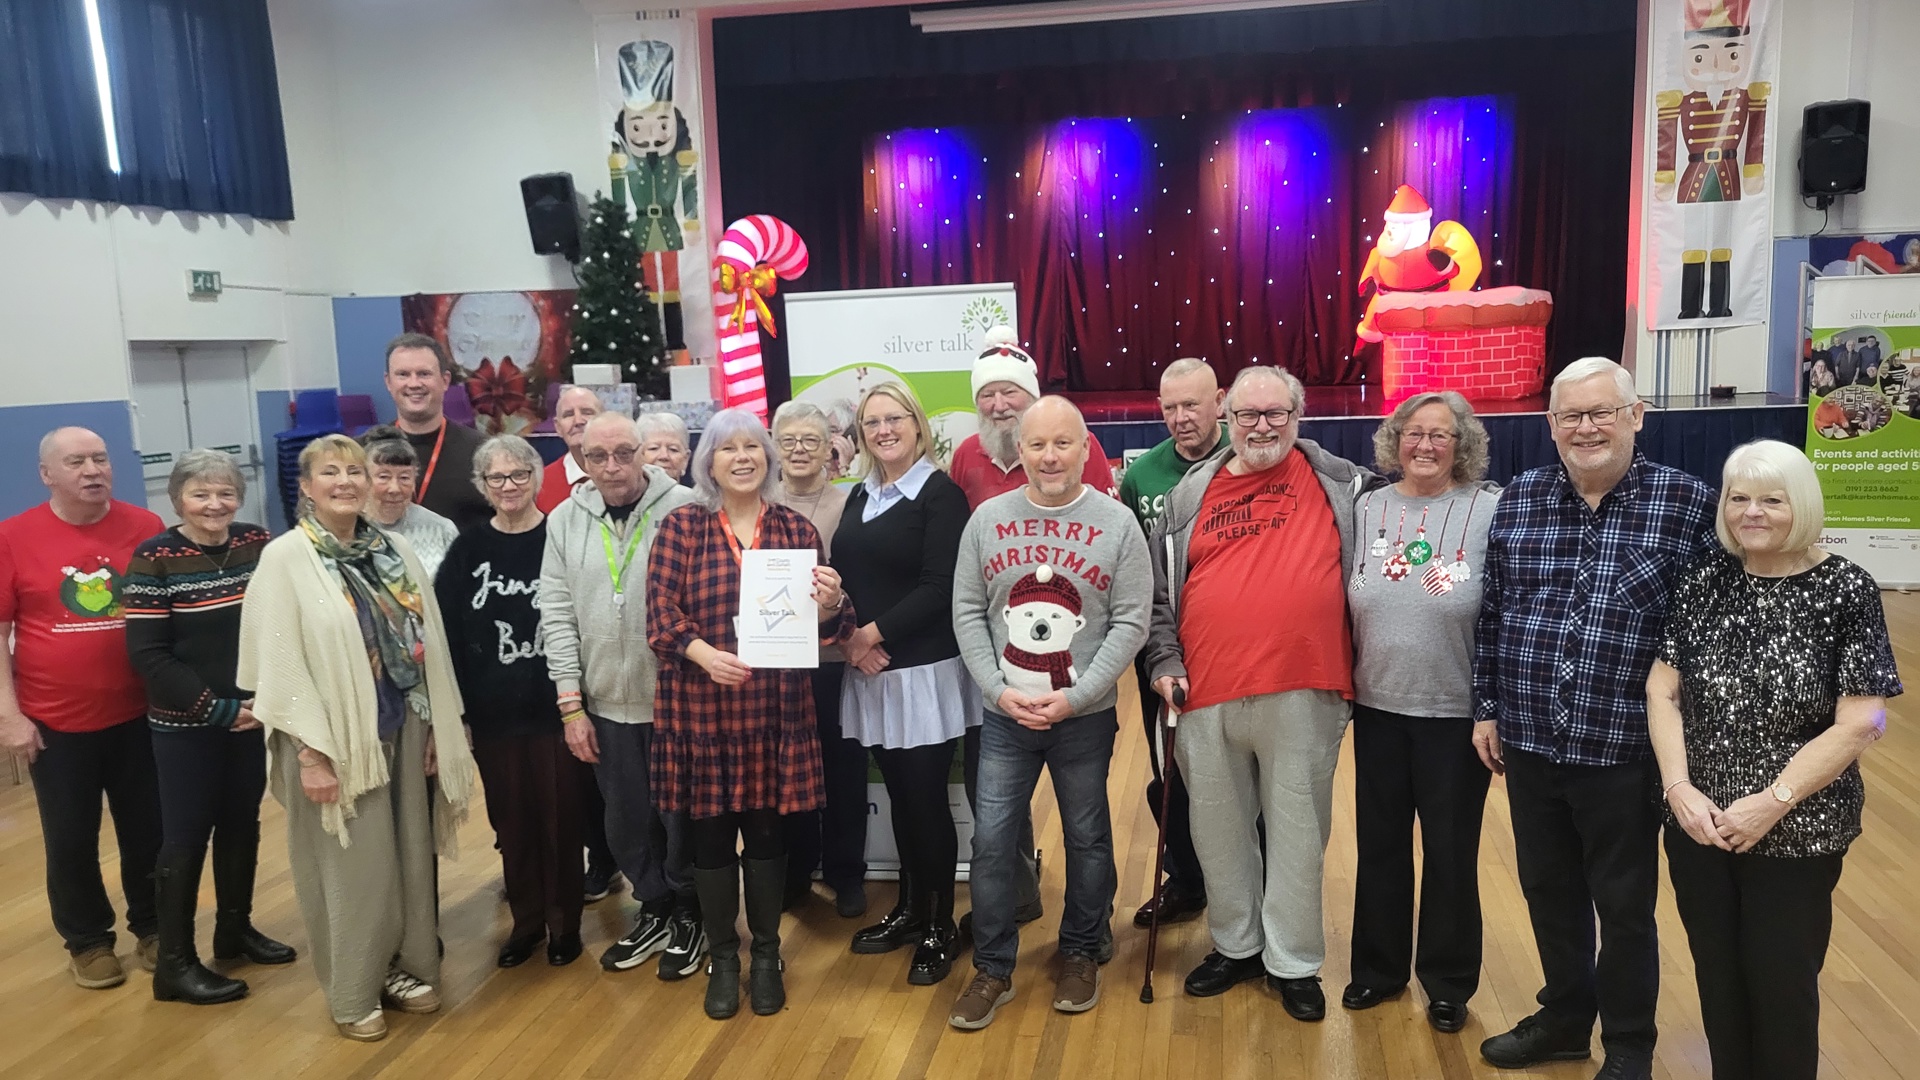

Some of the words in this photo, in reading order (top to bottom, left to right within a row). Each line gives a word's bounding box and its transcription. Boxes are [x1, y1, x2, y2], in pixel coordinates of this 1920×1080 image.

[1850, 309, 1881, 320] silver
[1883, 309, 1917, 323] friends
[883, 335, 933, 354] silver
[940, 332, 974, 352] talk
[1814, 449, 1853, 458] Events
[1855, 449, 1878, 458] and
[1881, 448, 1920, 458] activit
[1832, 461, 1875, 473] people
[1877, 461, 1908, 473] aged
[1911, 461, 1920, 471] 5
[995, 518, 1103, 547] MERRY
[1217, 524, 1260, 542] PLEASE
[983, 545, 1111, 591] CHRISTMAS
[471, 561, 541, 610] Jing
[493, 619, 545, 665] Bel
